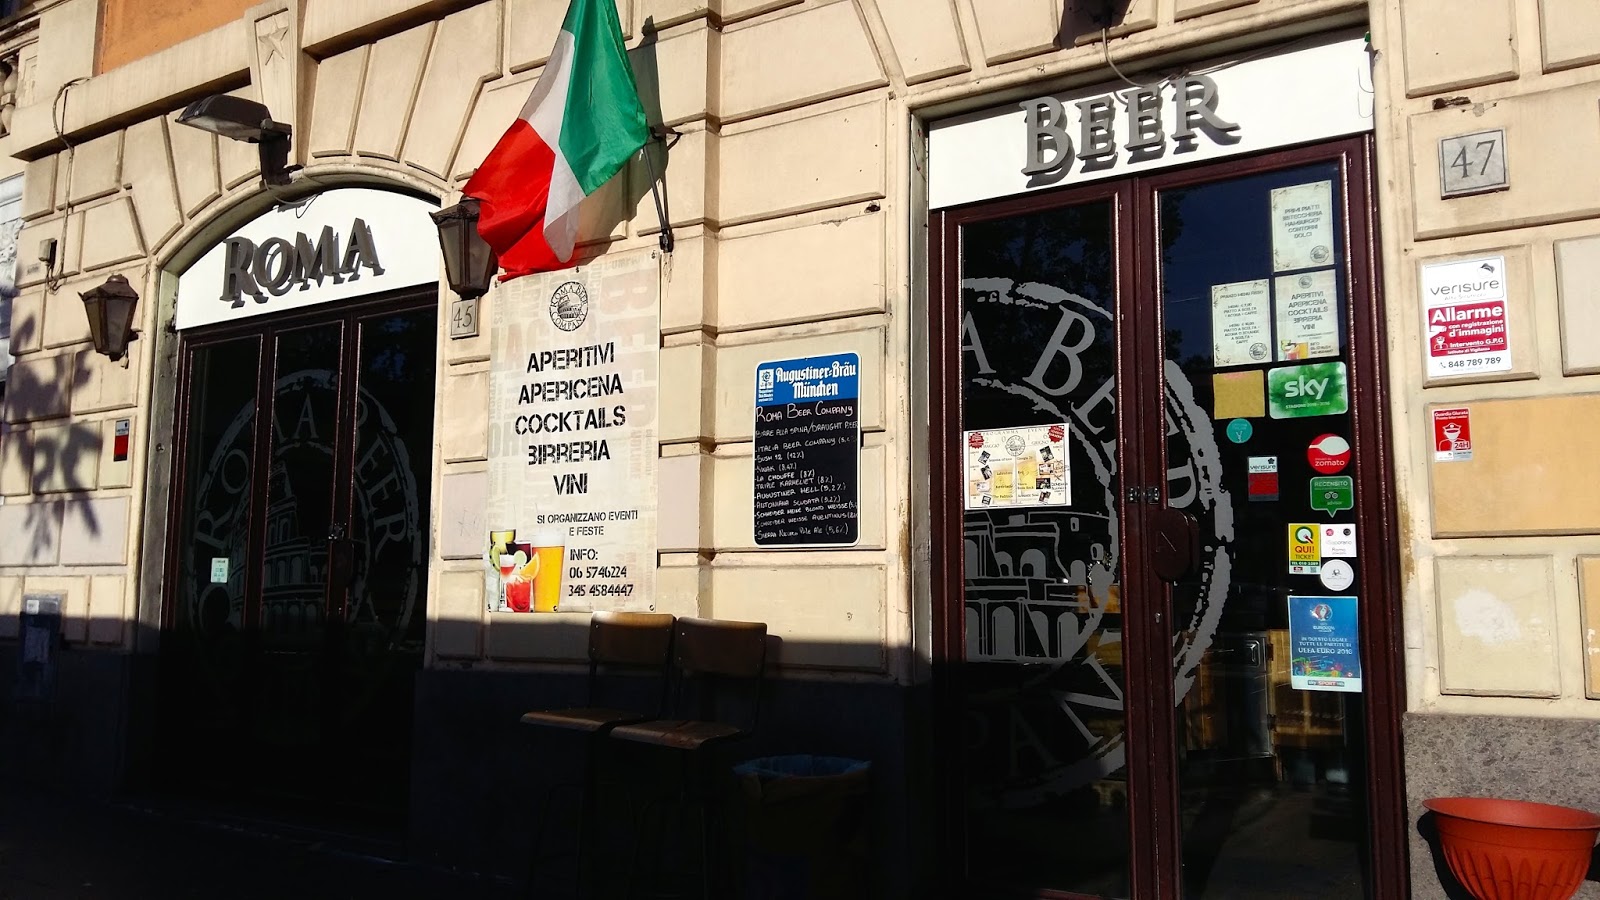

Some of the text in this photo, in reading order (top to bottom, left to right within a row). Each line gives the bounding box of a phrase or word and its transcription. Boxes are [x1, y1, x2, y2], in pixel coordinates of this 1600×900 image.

[1020, 75, 1242, 180] BEER
[1451, 140, 1496, 179] 47
[220, 217, 384, 307] ROMA
[1430, 280, 1499, 296] verisure
[453, 304, 474, 328] 45
[1288, 306, 1329, 316] COCKTAILS
[1432, 306, 1502, 323] Allarme
[1461, 320, 1503, 328] registrazione
[1450, 340, 1484, 348] Intervento
[527, 342, 615, 373] APERITIVI
[518, 373, 624, 405] APERICENA
[793, 380, 838, 399] München
[1285, 375, 1329, 400] sky
[515, 405, 626, 435] COCKTAILS
[756, 400, 853, 422] ROMA BEER COMPANY
[528, 440, 610, 466] BIRRERIA
[783, 441, 802, 450] BEER
[553, 473, 588, 495] VINI
[537, 510, 638, 524] SI ORGANIZZANO EVENTI
[569, 525, 604, 536] E FESTE
[570, 548, 598, 561] INFO:
[570, 566, 627, 578] 06 5746224
[568, 584, 634, 596] 345 4584447
